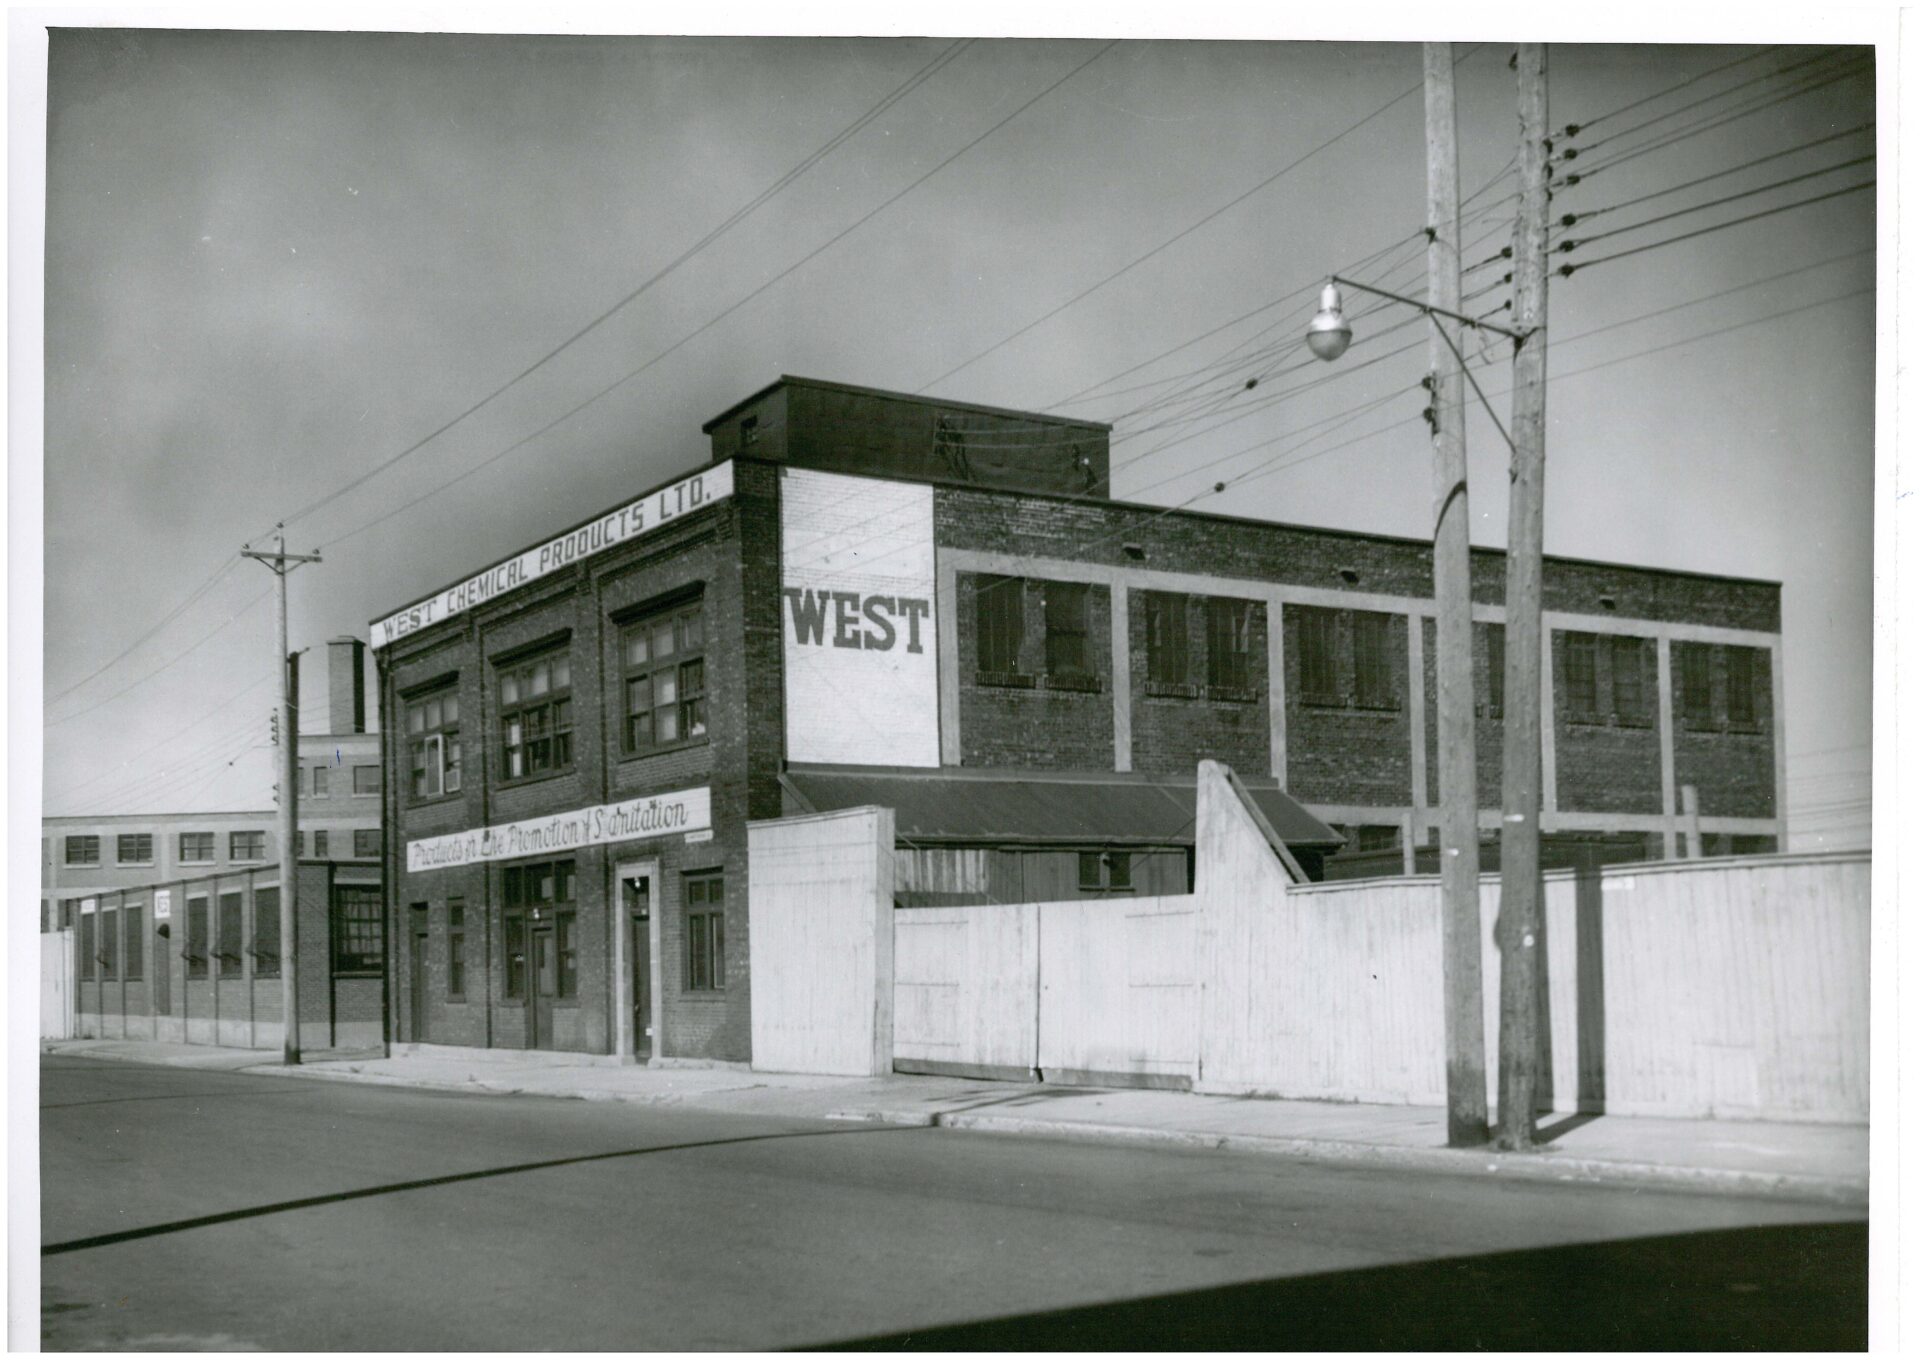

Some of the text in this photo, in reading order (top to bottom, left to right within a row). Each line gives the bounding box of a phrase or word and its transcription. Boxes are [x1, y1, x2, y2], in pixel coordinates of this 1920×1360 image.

[383, 476, 711, 643] WEST CHEMICAL PRODUCTS LTD.
[782, 587, 929, 654] WEST
[507, 816, 578, 853] Promotion
[594, 799, 689, 839] Sanitation
